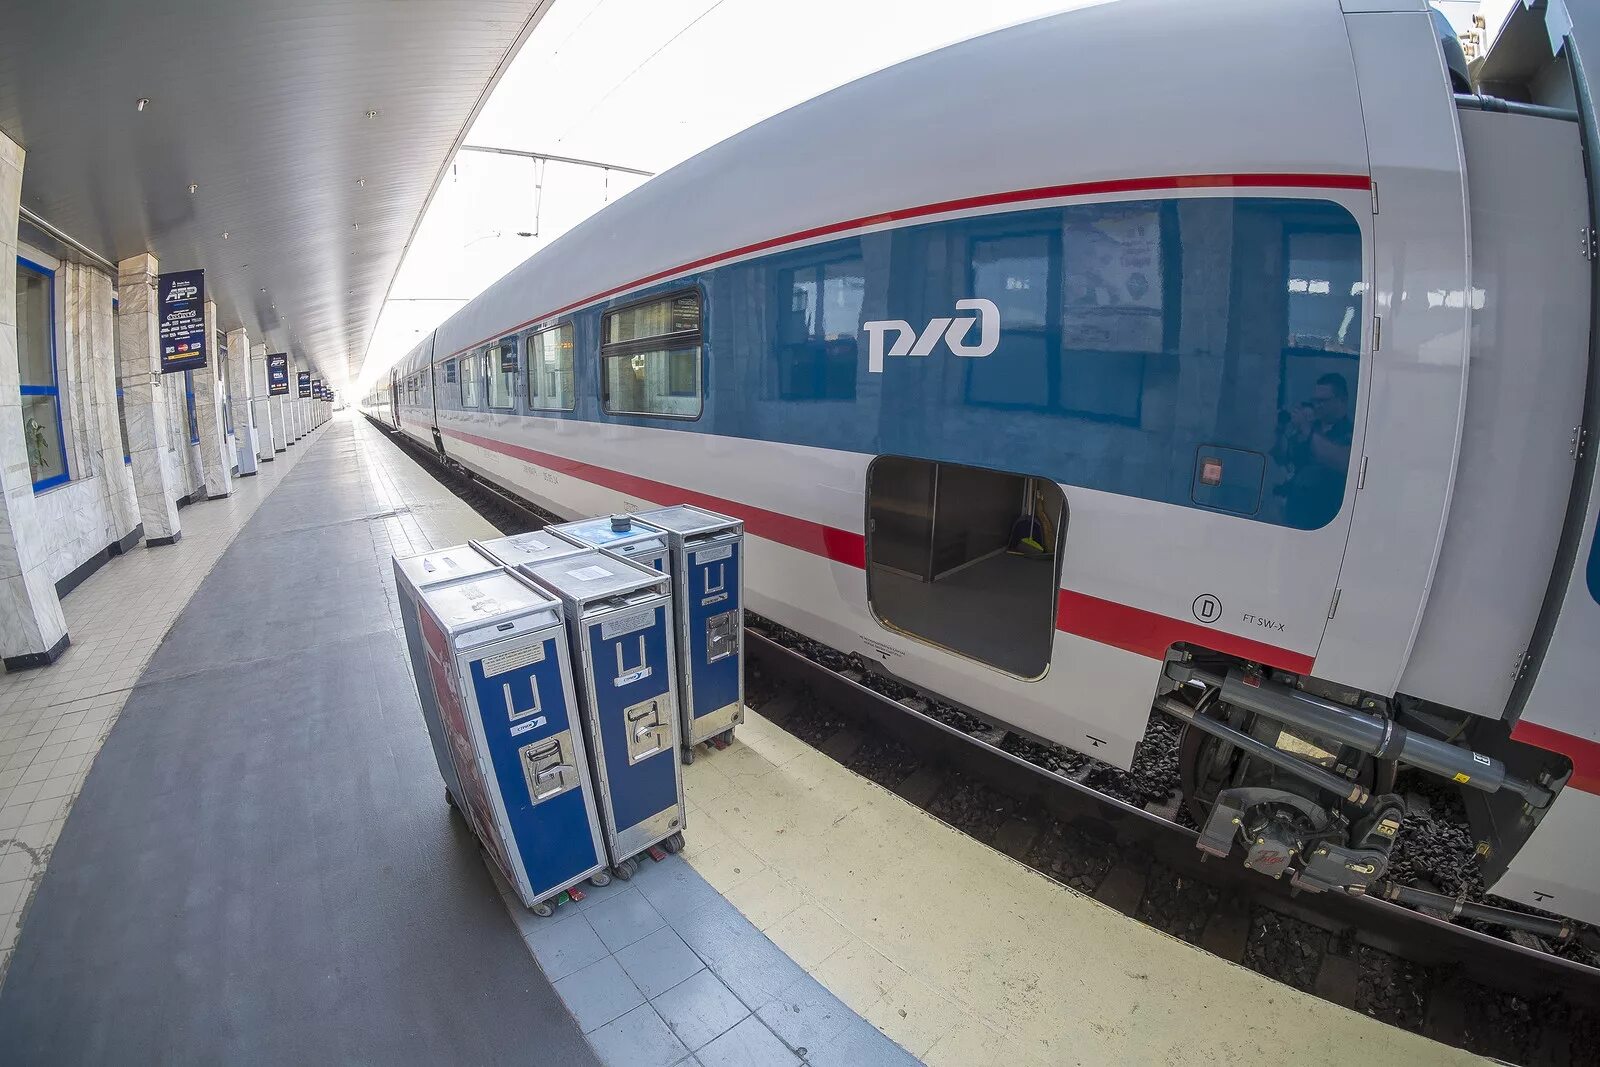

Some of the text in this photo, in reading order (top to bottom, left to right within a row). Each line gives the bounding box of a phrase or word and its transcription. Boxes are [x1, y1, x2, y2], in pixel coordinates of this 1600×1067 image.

[165, 286, 197, 301] AFP
[1201, 600, 1215, 618] D
[1242, 613, 1285, 632] FT SW-X
